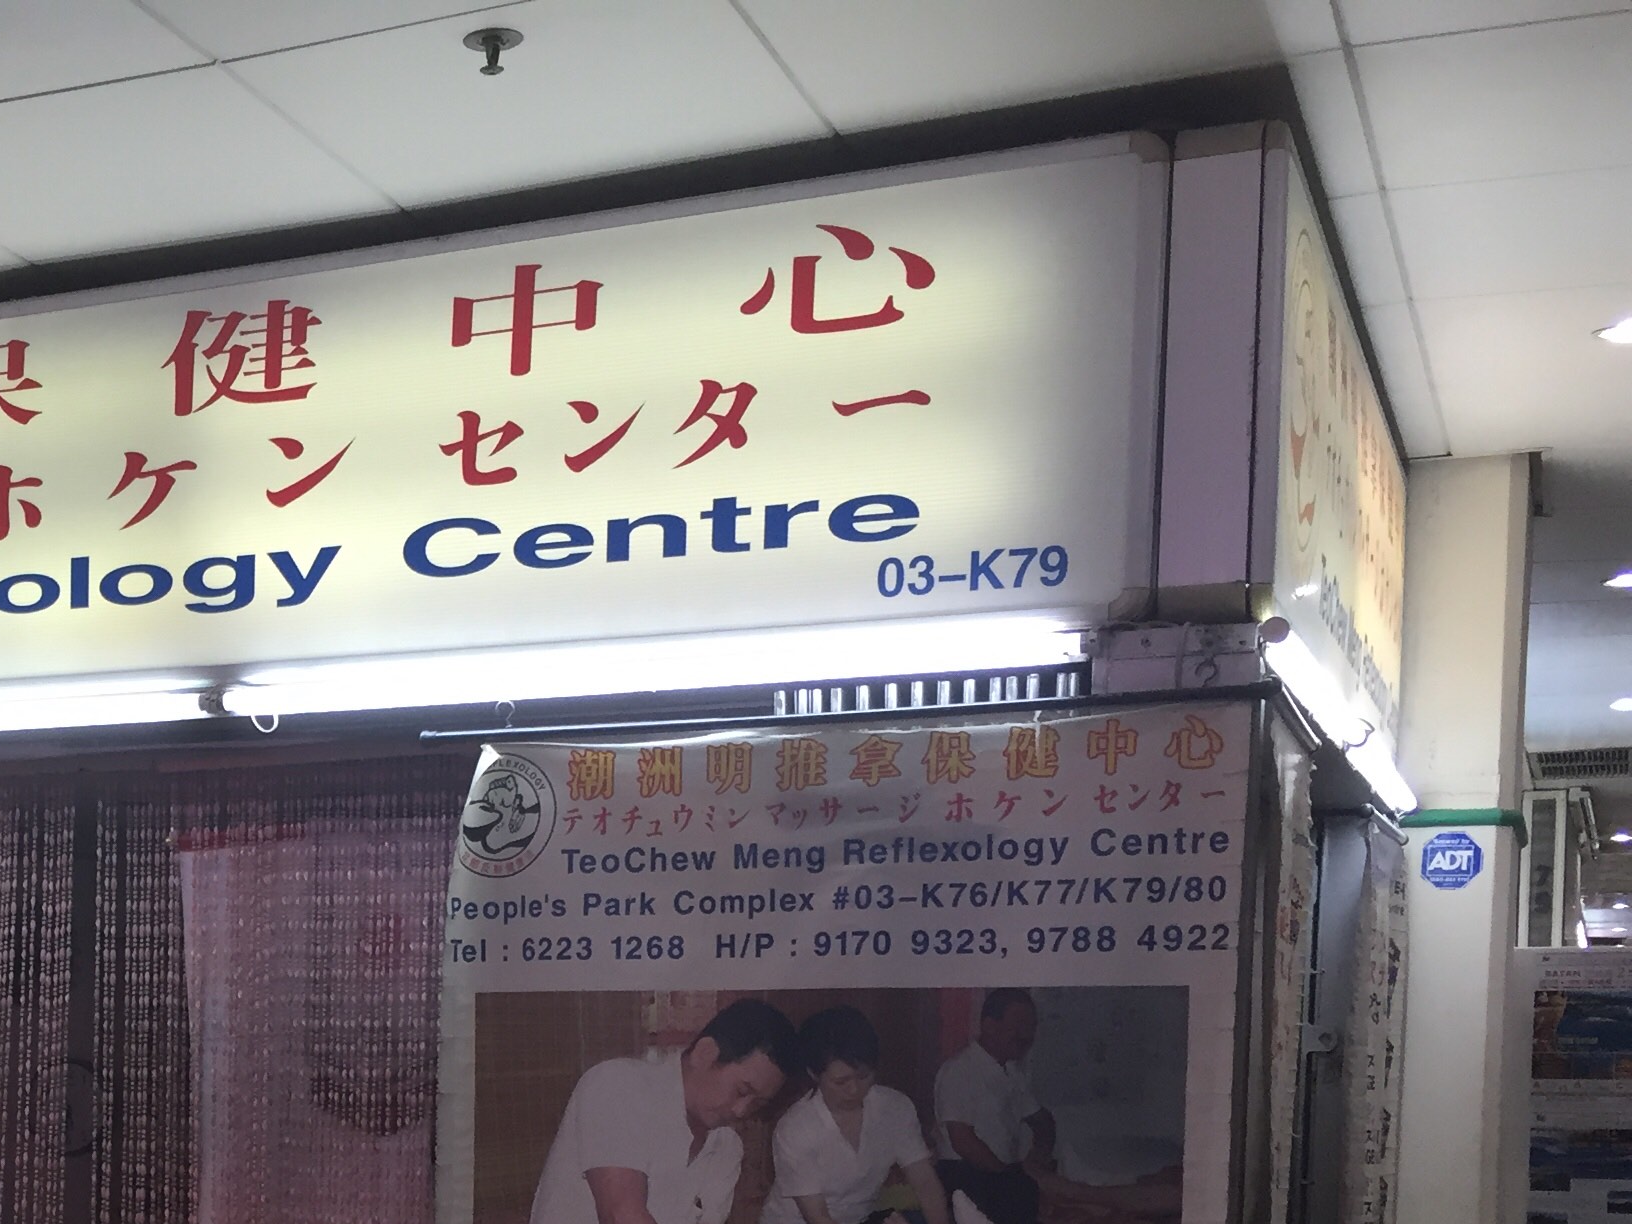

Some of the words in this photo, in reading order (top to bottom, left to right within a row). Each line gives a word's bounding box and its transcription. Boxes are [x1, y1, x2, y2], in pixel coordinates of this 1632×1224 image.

[401, 491, 921, 579] Centre
[876, 544, 1070, 599] 03-K79
[567, 714, 1225, 801] 潮洲明推拿保健中心
[561, 846, 716, 875] TeoChew
[733, 843, 826, 874] Meng
[843, 833, 1069, 867] Reflexology
[1090, 827, 1230, 857] Centre
[1428, 849, 1474, 871] ADT
[451, 893, 566, 925] People's
[582, 890, 656, 916] Park
[673, 887, 814, 922] Complex
[832, 876, 1227, 909] #03-K76/K77/K79/80
[521, 937, 592, 962] 6223
[611, 935, 685, 960] 1268
[715, 932, 775, 960] H/P
[813, 930, 892, 957] 9170
[1026, 926, 1117, 954] 9788
[1136, 924, 1231, 952] 4922
